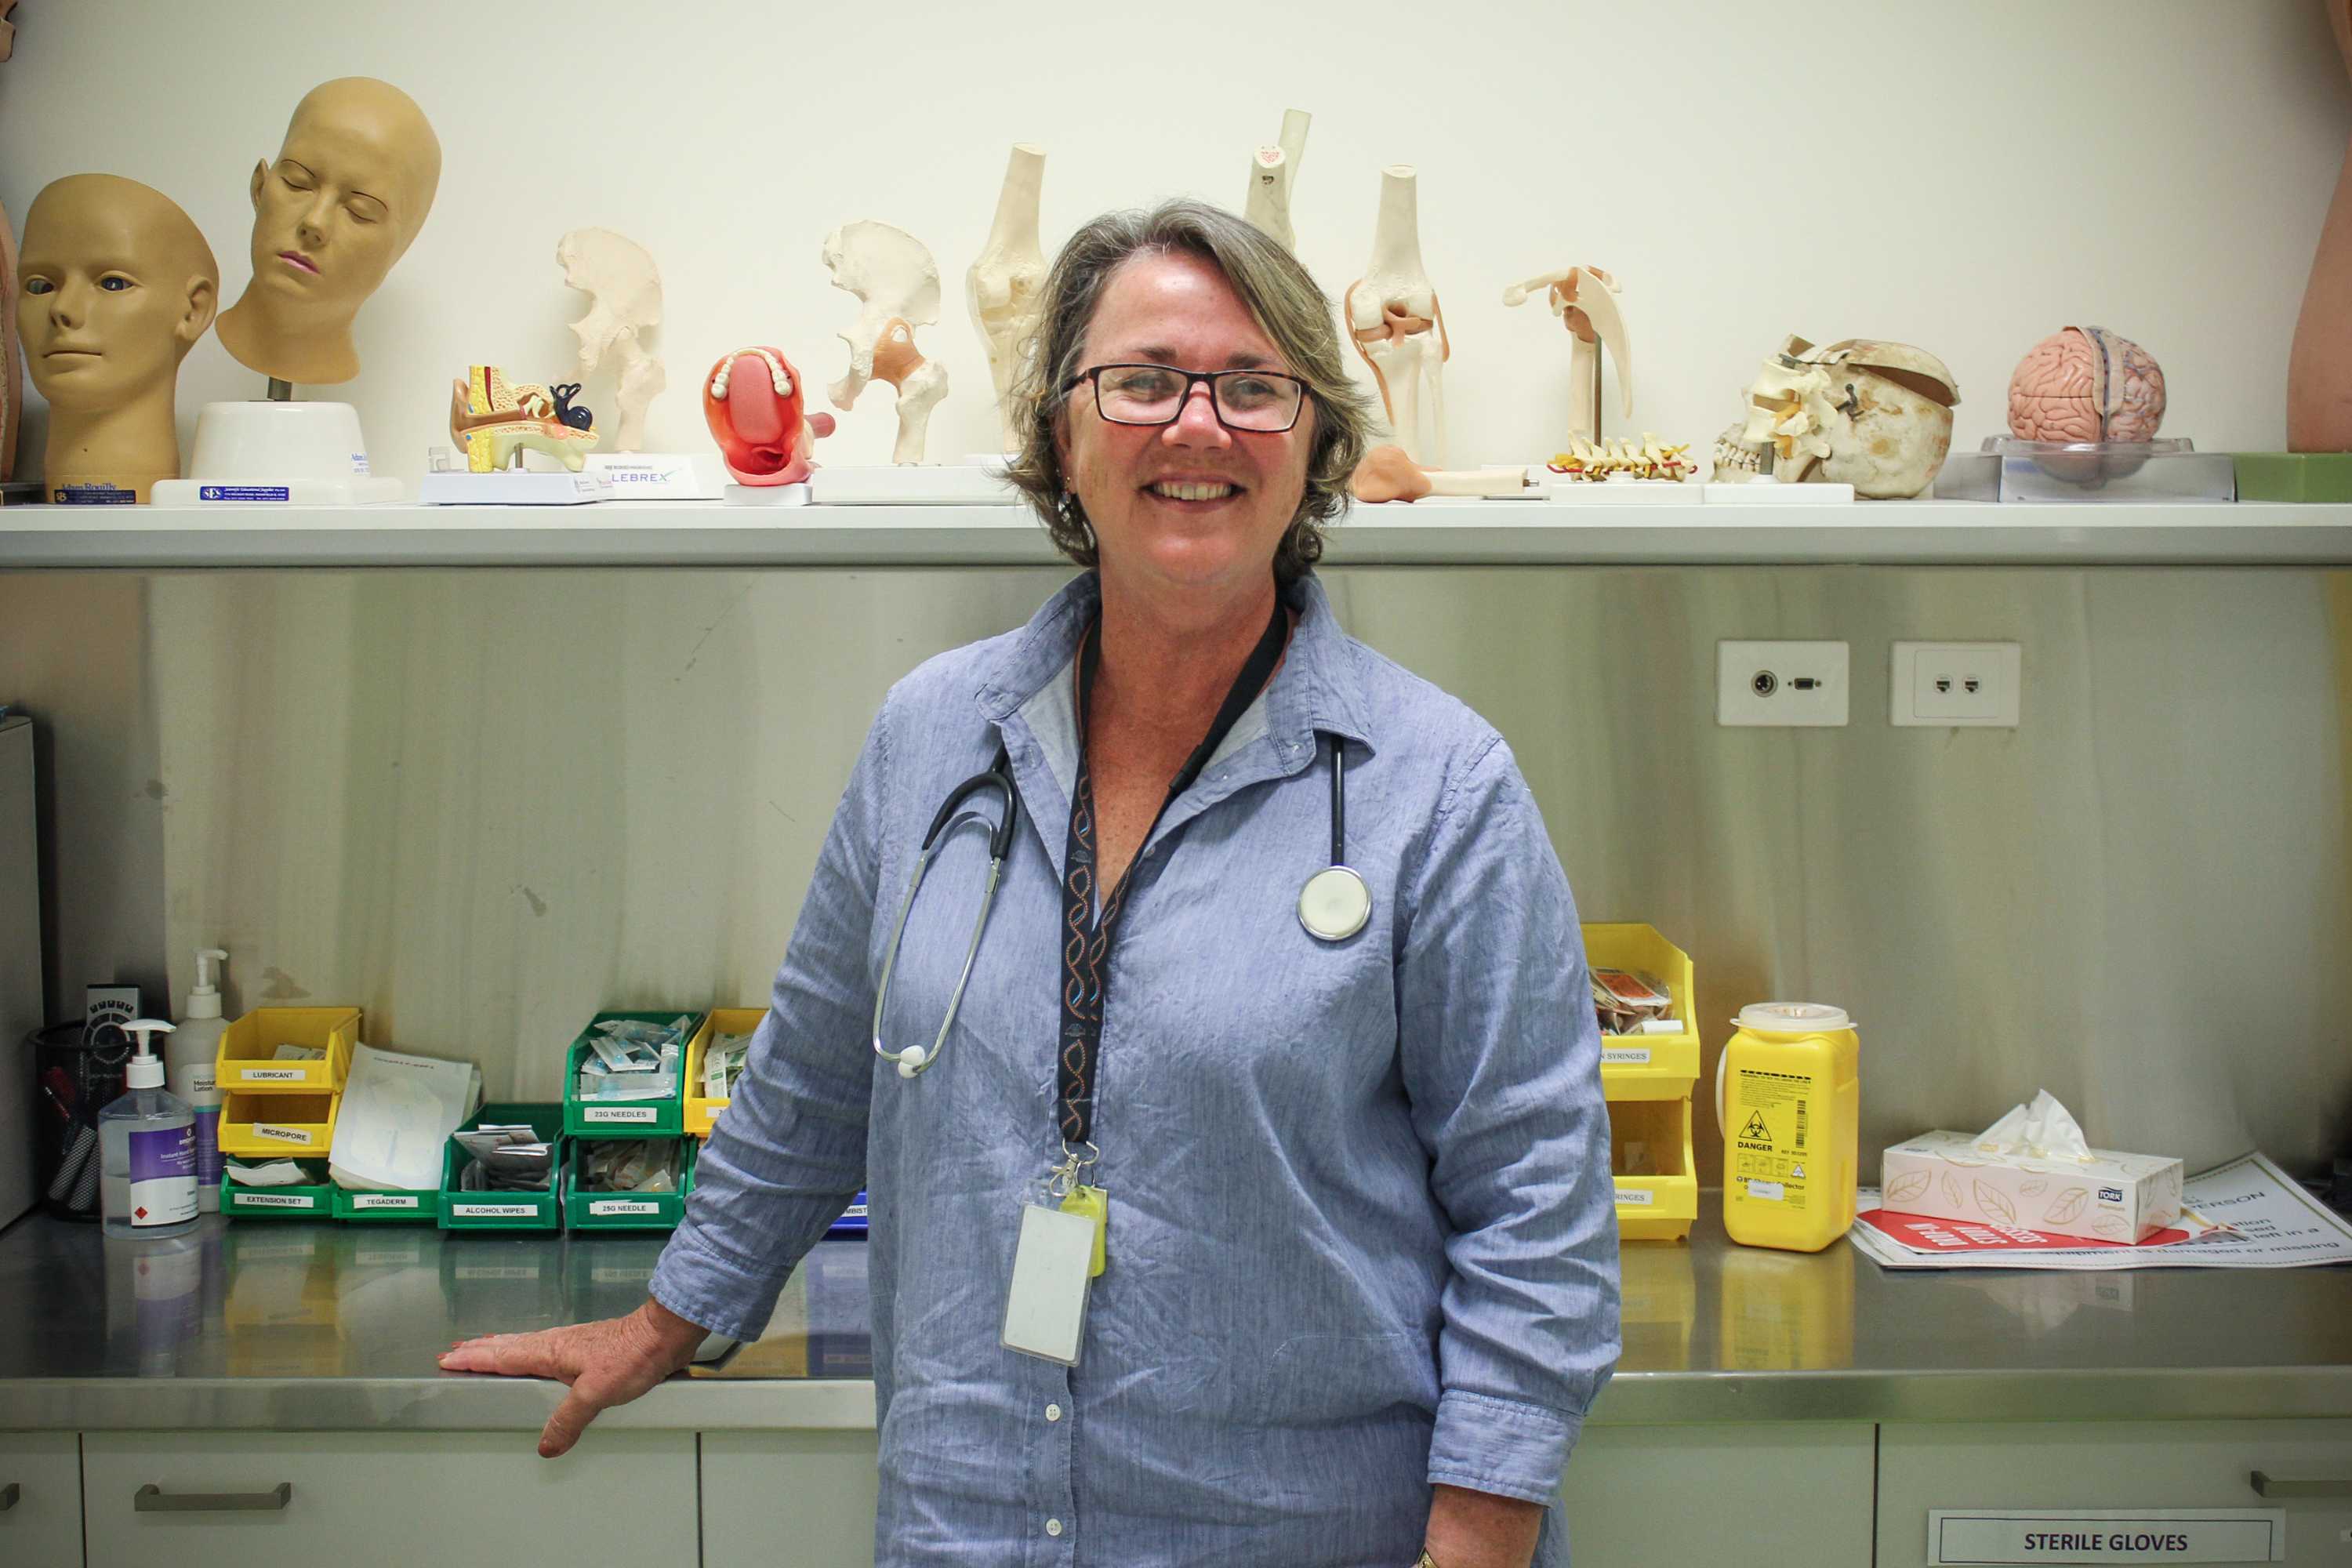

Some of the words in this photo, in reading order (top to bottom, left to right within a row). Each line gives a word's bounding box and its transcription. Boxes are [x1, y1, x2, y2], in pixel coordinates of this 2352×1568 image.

[612, 472, 671, 482] LEBREX
[261, 1127, 307, 1142] MICROPORE
[1737, 1142, 1773, 1152] DANGER
[2100, 1191, 2121, 1201] TORK
[2270, 1241, 2340, 1253] missing
[2024, 1534, 2103, 1551] STERILE
[2109, 1534, 2188, 1552] GLOVES
